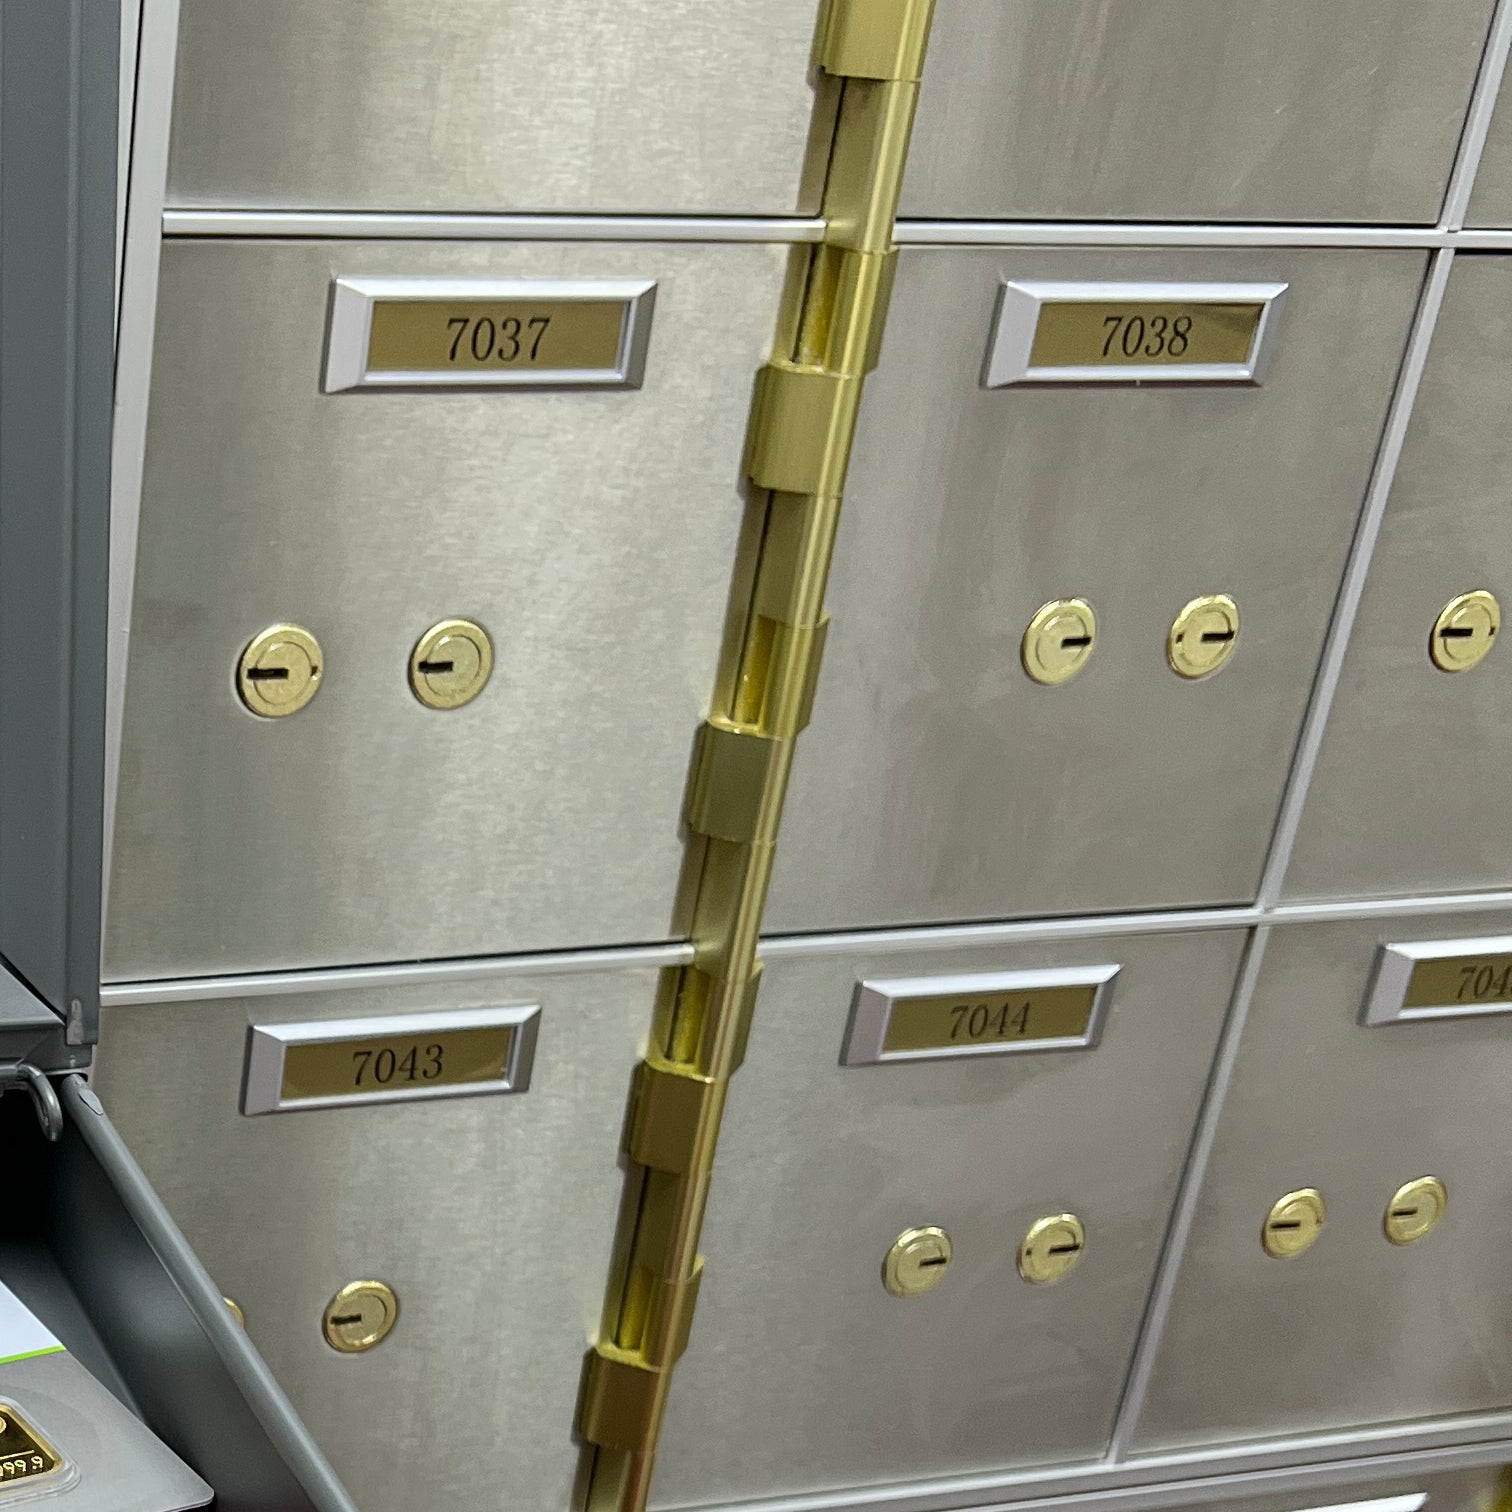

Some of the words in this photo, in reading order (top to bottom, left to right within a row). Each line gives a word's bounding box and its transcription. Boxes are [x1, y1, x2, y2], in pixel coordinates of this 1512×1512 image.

[447, 316, 551, 362] 7037
[1102, 315, 1193, 358] 7038
[1456, 964, 1512, 999] 704
[949, 1001, 1031, 1040] 7044
[352, 1043, 444, 1087] 7043
